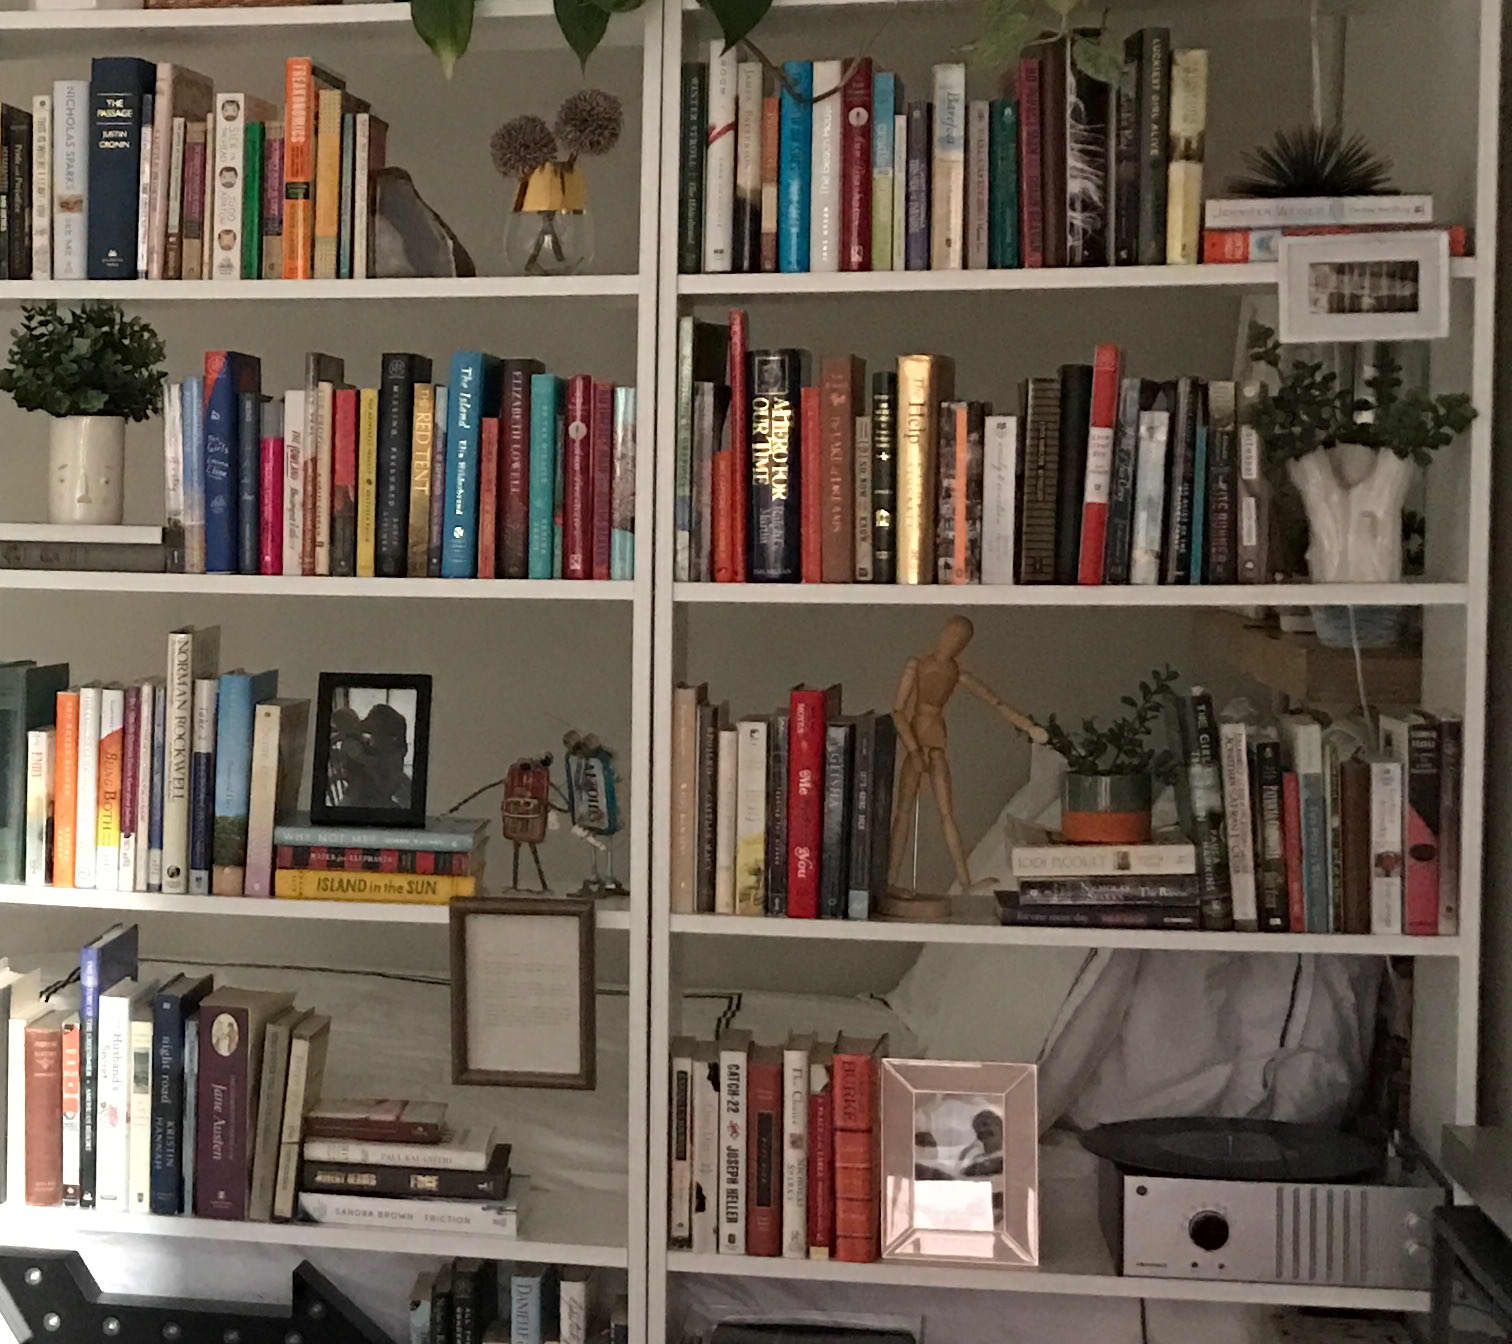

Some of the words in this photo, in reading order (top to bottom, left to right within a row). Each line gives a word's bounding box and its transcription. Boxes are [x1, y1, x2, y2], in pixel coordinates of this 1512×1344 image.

[1151, 38, 1161, 91] LUCKIEST
[64, 86, 76, 147] NICHOLAS
[96, 108, 134, 119] PASSAGE
[105, 98, 125, 108] THE
[290, 63, 308, 144] FREAKONOMICS
[942, 91, 961, 146] Barefoot
[1151, 93, 1161, 119] GIRL
[1149, 122, 1160, 157] ALIVE
[460, 366, 473, 388] The
[458, 391, 472, 430] Island
[510, 370, 523, 440] ELIZABETH
[752, 396, 770, 435] OUR
[772, 396, 789, 409] A
[415, 411, 431, 445] RED
[771, 408, 793, 462] HERO
[903, 401, 926, 446] Help
[413, 448, 429, 495] TENT
[509, 443, 522, 496] LOWELL
[751, 437, 773, 486] TIME
[771, 466, 788, 502] FOR
[173, 640, 190, 711] NORMAN
[796, 702, 807, 734] MOYES
[1197, 703, 1208, 729] THE
[103, 751, 119, 787] BEING
[171, 714, 188, 802] ROCKWELL
[797, 768, 813, 796] Me
[828, 752, 841, 808] GEISHA
[102, 789, 118, 831] BOTH
[318, 832, 345, 845] NOT
[793, 846, 816, 879] You
[316, 876, 368, 894] ISLAND
[369, 879, 381, 894] in
[383, 879, 404, 895] the
[406, 879, 438, 896] SUN
[159, 1036, 176, 1070] night
[160, 1074, 173, 1104] road
[210, 1083, 228, 1114] Jane
[726, 1063, 741, 1114] CATCH-22
[155, 1116, 164, 1170] HANNAH
[165, 1120, 176, 1168] KRISTIN
[211, 1115, 227, 1161] Austen
[725, 1144, 740, 1185] JOSEPH
[335, 1206, 375, 1219] SANDRA
[377, 1209, 415, 1221] BROWN
[424, 1213, 471, 1226] FRICTION
[725, 1187, 740, 1224] HELLER
[464, 1307, 472, 1325] ALL
[515, 1283, 534, 1339] DANIELLE
